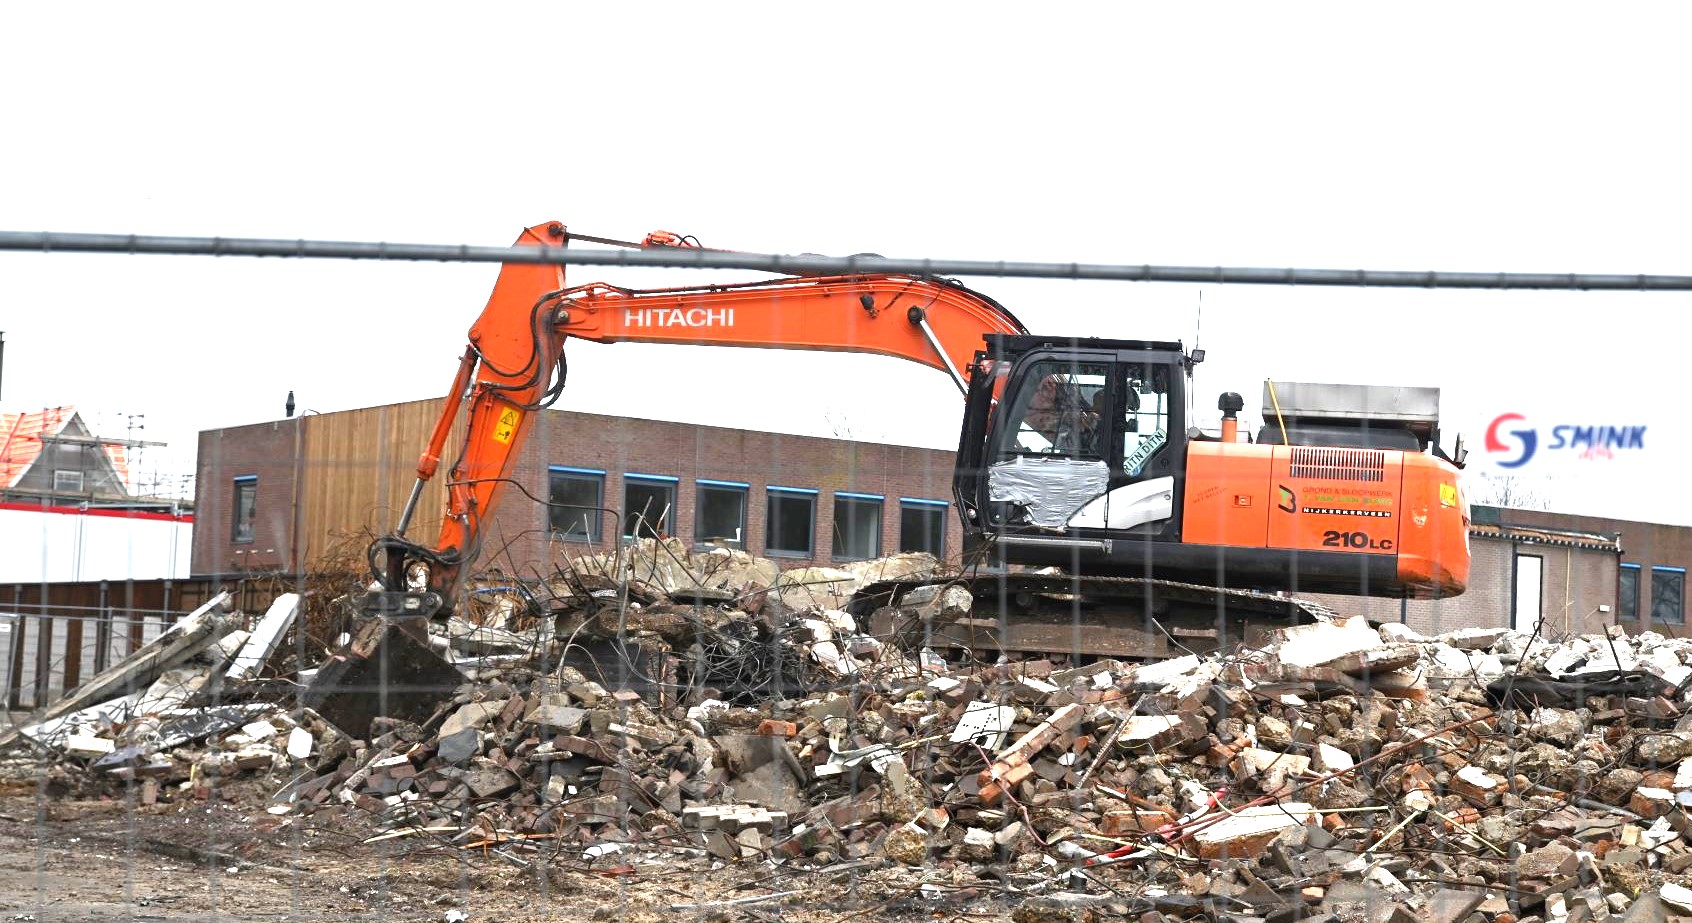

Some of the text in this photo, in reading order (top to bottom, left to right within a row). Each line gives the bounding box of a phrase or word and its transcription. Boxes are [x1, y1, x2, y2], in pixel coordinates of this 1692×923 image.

[624, 308, 734, 327] HITACHI
[1142, 431, 1165, 454] DITN
[1547, 424, 1647, 449] SMINK
[1303, 507, 1391, 517] NIJKERKERVEEN
